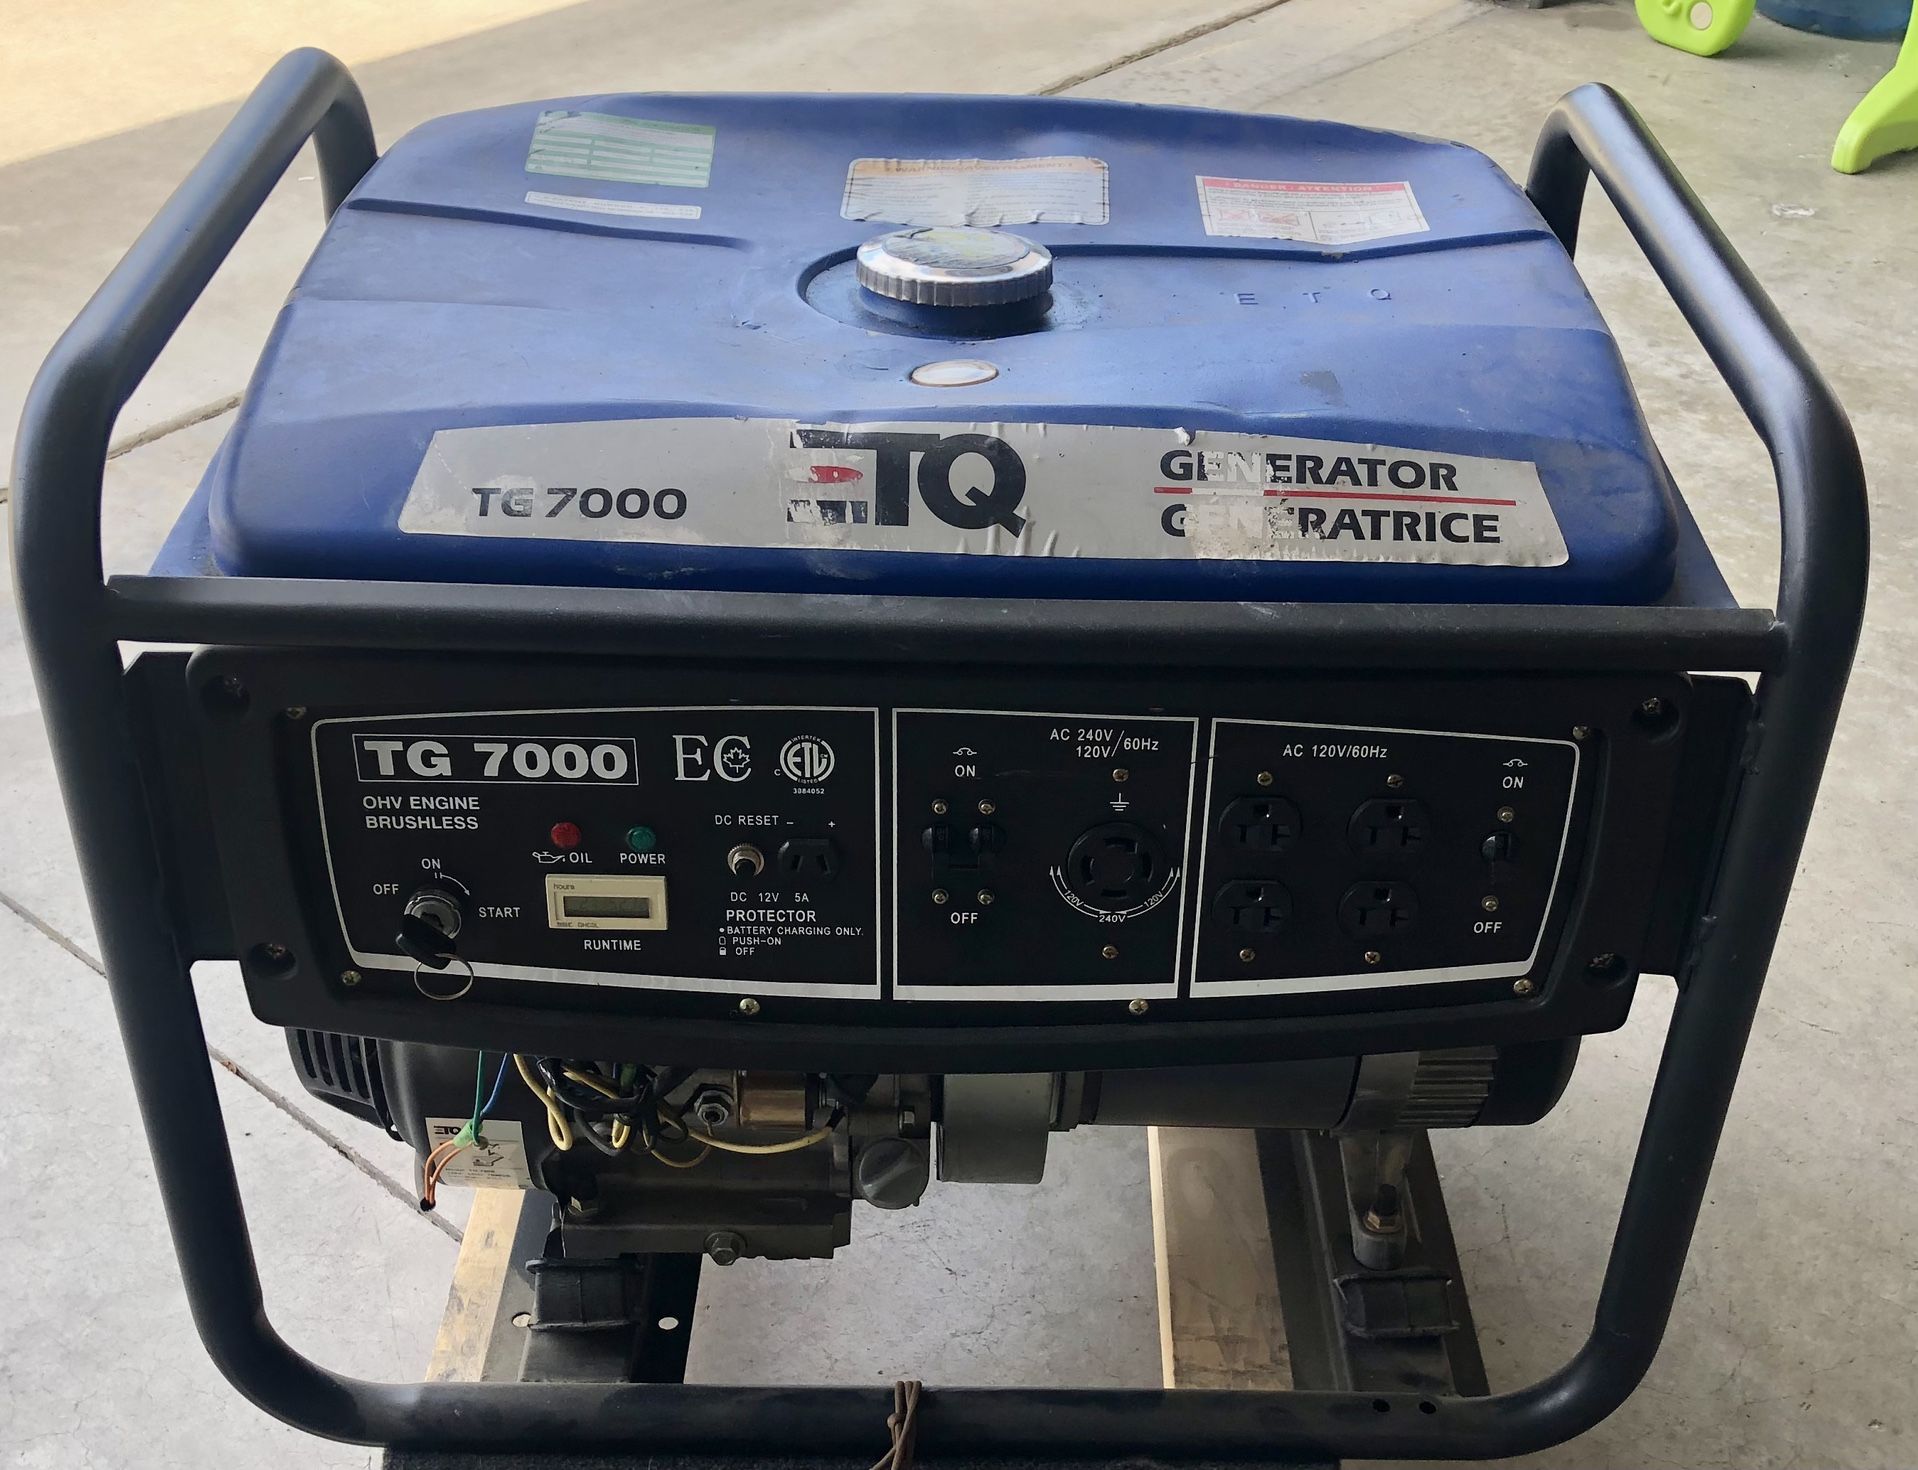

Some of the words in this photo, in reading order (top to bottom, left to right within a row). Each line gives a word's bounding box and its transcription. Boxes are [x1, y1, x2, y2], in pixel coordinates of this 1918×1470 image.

[1160, 449, 1458, 491] GENERATOR
[472, 487, 534, 518] TG
[545, 487, 688, 520] 7000
[1161, 503, 1501, 544] GERATRICE
[1050, 728, 1070, 741] AC
[1077, 728, 1113, 742] 240V
[1076, 745, 1111, 758] 120V
[1282, 743, 1303, 757] AC
[1312, 744, 1388, 758] 120V/60Hz
[363, 740, 452, 777] TG
[474, 742, 629, 779] 7000
[954, 764, 977, 778] ON
[1502, 776, 1524, 789] ON
[793, 787, 825, 795] 3084052
[362, 795, 402, 810] OHV
[409, 796, 480, 810] ENGINE
[366, 815, 479, 830] BRUSHLESS
[714, 814, 732, 826] DC
[738, 815, 779, 826] RESET
[421, 858, 441, 870] ON
[569, 851, 593, 864] OIL
[620, 853, 666, 865] POWER
[373, 883, 399, 895] OFF
[730, 891, 747, 902] DC
[758, 892, 779, 903] 12V
[794, 892, 809, 903] 5A
[1064, 890, 1084, 907] 120V
[1144, 891, 1164, 907] 120V
[478, 906, 521, 918] START
[726, 909, 817, 923] PROTECTOR
[950, 912, 978, 925] OFF
[1098, 914, 1126, 923] 240V
[727, 926, 772, 935] BATTERY
[777, 926, 831, 936] CHARGING
[835, 927, 864, 936] ONLY.
[1473, 921, 1502, 934] OFF
[584, 939, 642, 951] RUNTIME
[732, 936, 782, 946] PUSH-ON
[735, 947, 755, 956] OFF
